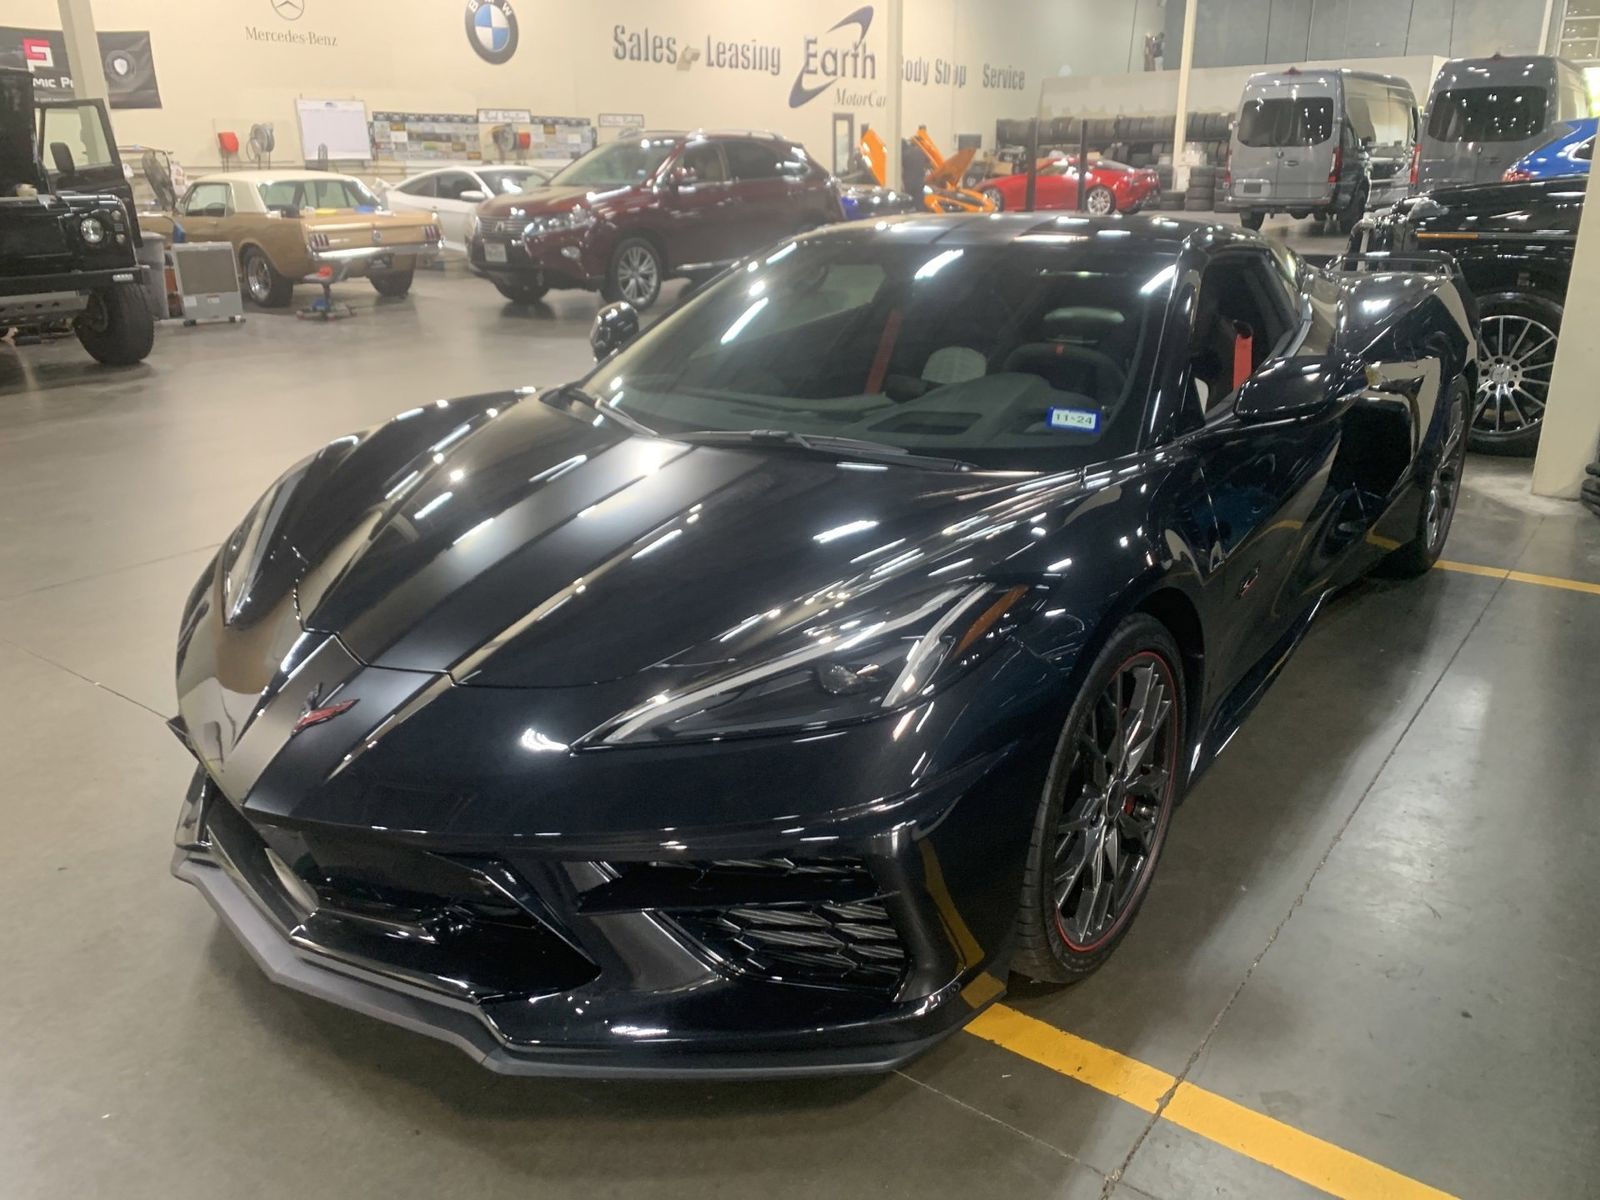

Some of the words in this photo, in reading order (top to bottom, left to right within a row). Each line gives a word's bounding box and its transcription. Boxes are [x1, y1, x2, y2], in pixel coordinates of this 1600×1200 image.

[469, 0, 513, 16] BW
[613, 24, 678, 65] Sales
[706, 34, 781, 76] Leasing
[803, 36, 876, 80] Earth
[982, 63, 1026, 91] Service
[1055, 413, 1093, 425] 11-24
